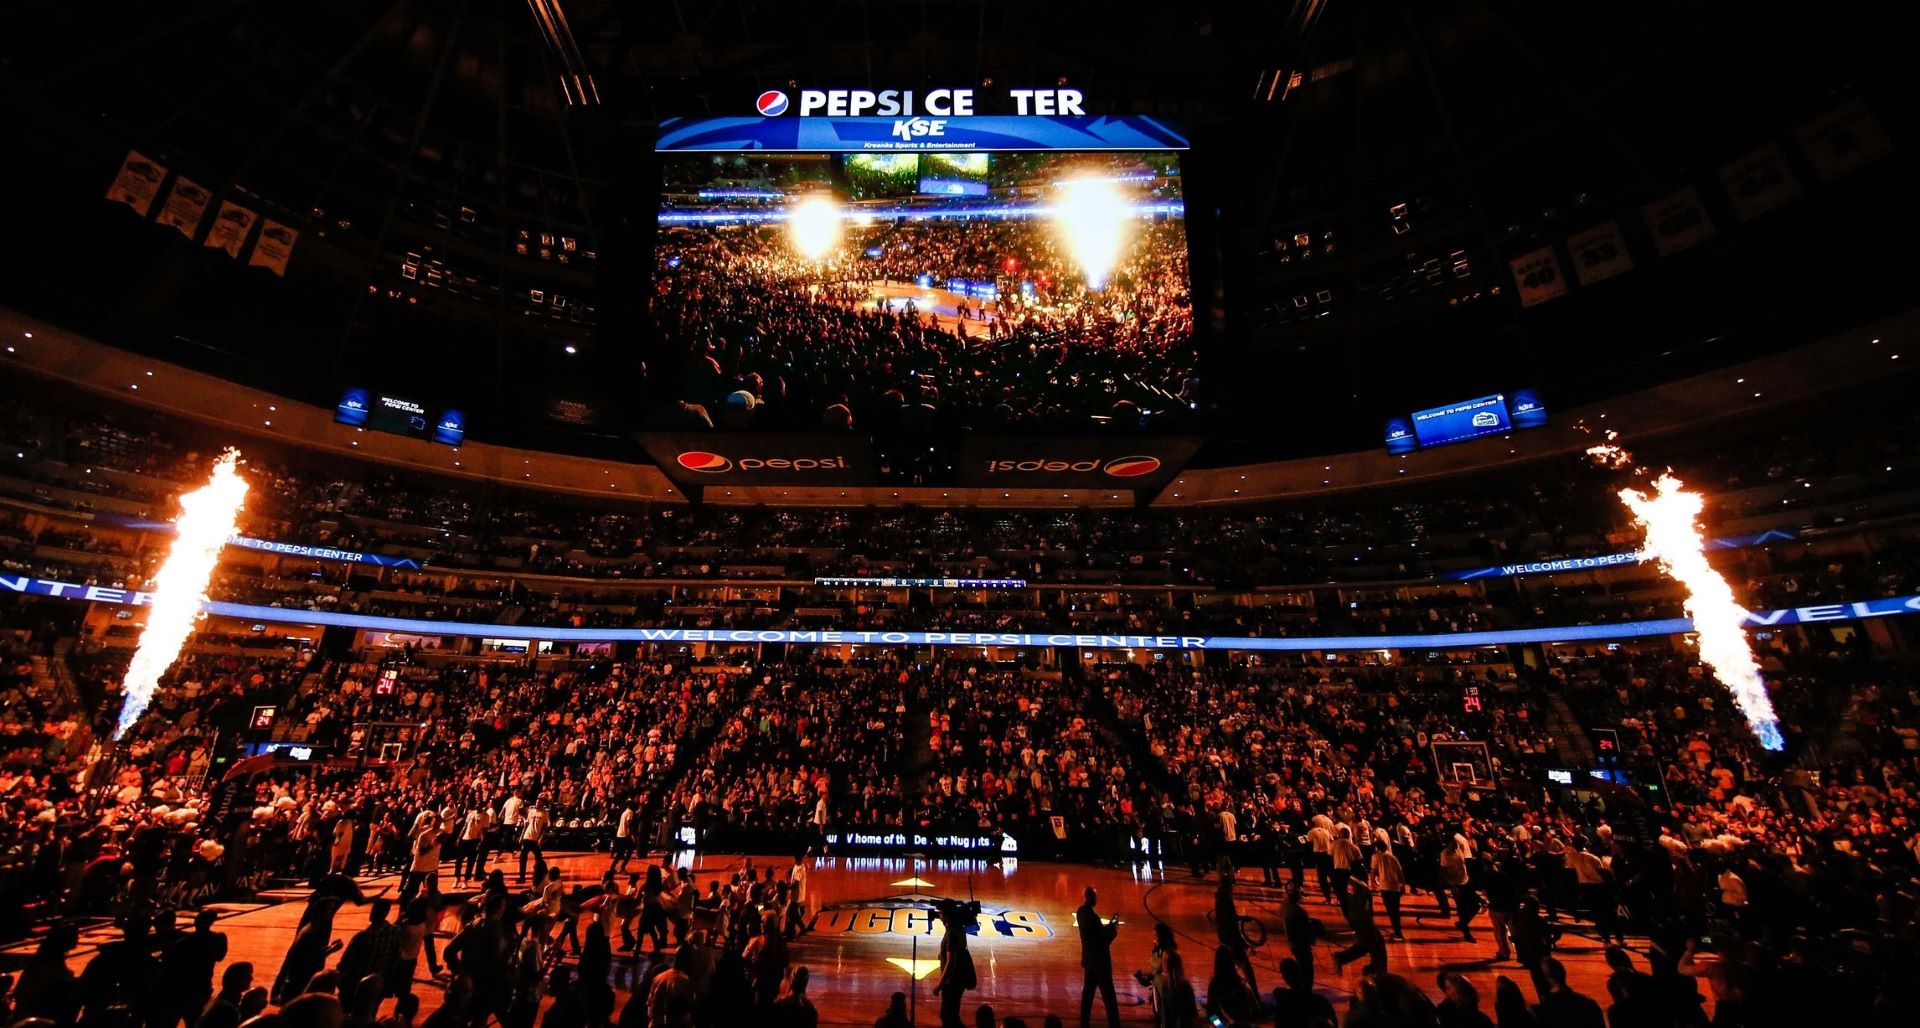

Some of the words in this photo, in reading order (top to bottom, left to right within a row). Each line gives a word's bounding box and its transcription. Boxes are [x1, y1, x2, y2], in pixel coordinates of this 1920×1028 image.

[800, 89, 913, 116] PEPSI
[892, 117, 948, 141] KSE
[739, 456, 846, 471] pepsi
[256, 540, 274, 550] TO
[276, 542, 313, 556] PEPSI
[315, 547, 363, 562] CENTER
[1502, 559, 1572, 575] WELCOME
[1576, 558, 1596, 568] TO
[641, 629, 843, 643] WELCOME
[857, 631, 910, 643] TO
[925, 632, 1033, 645] PEPSI
[1047, 634, 1207, 648] CENTER
[377, 678, 395, 694] 24
[1463, 696, 1481, 712] 24
[257, 716, 270, 726] 24
[855, 833, 882, 845] home
[884, 833, 894, 844] of
[896, 834, 906, 845] th
[796, 907, 1054, 938] UGGTS
